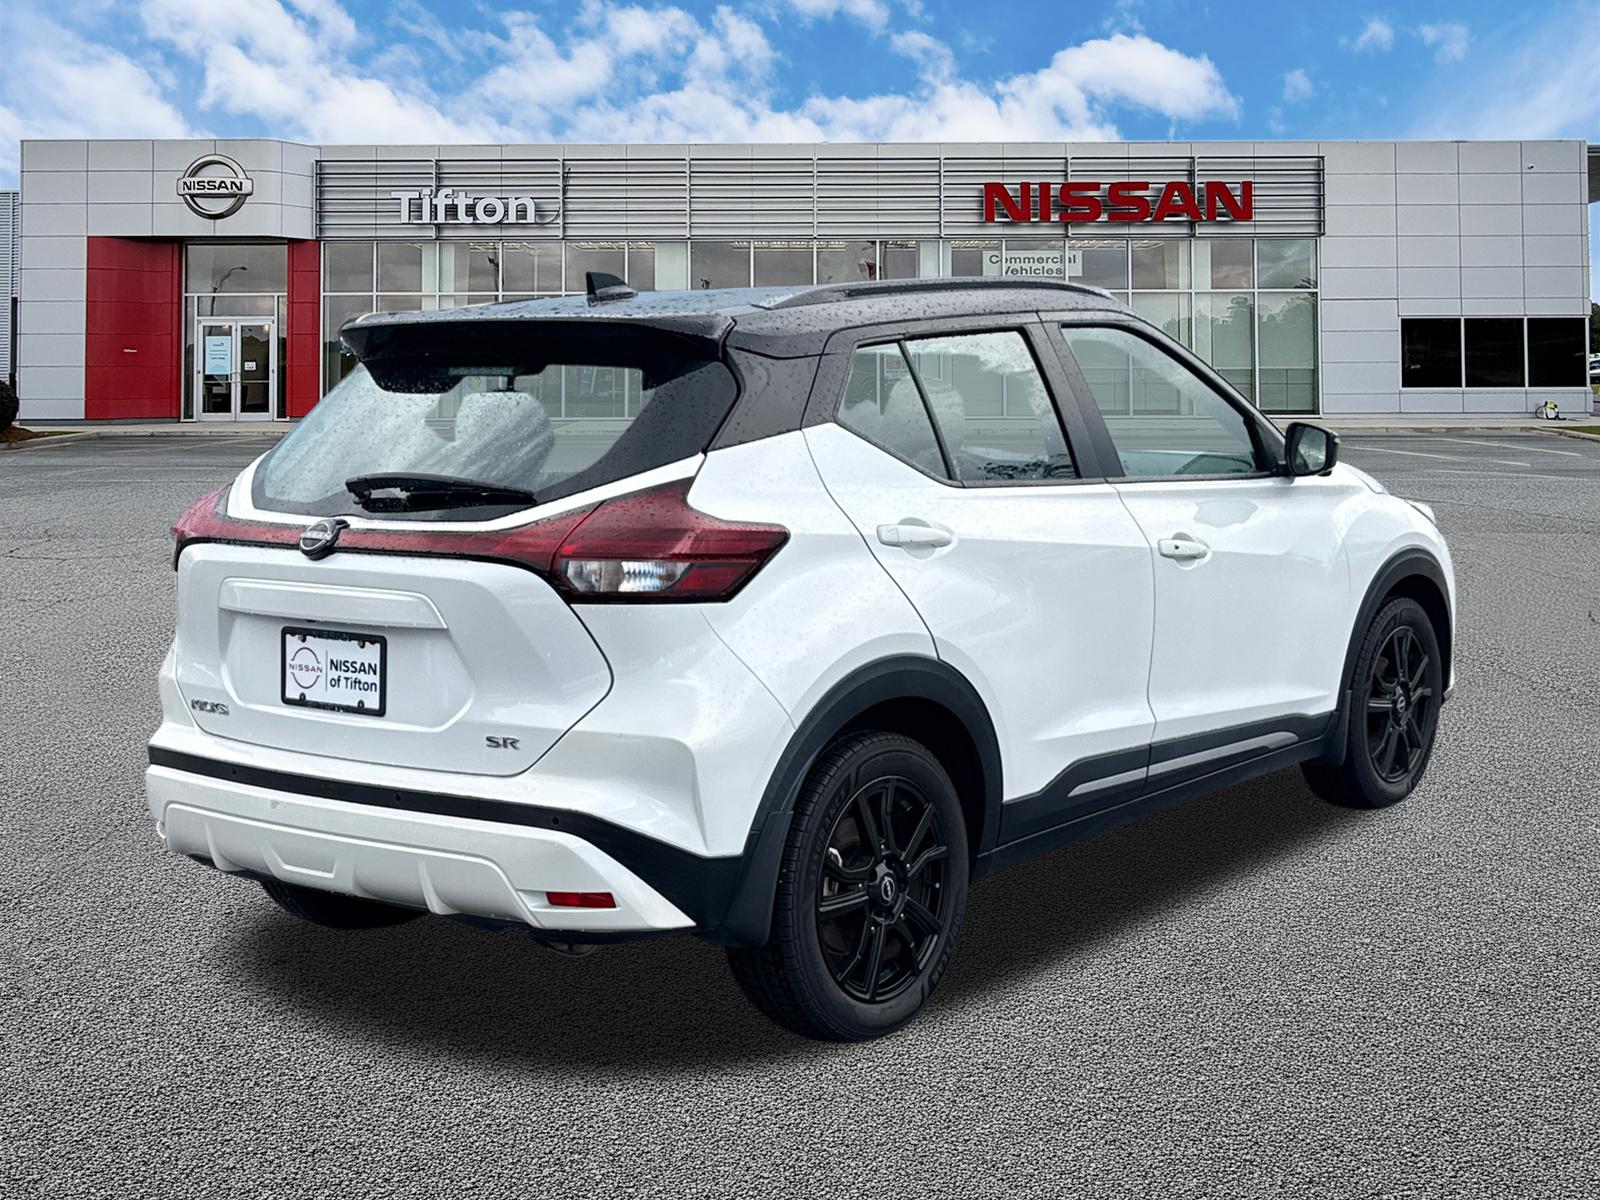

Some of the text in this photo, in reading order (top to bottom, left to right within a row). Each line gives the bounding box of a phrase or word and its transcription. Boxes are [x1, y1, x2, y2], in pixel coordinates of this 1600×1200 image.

[182, 180, 243, 192] NISSAN
[391, 188, 536, 224] Tifton
[984, 181, 1253, 222] NISSAN
[289, 663, 323, 673] NISSAN
[329, 658, 378, 676] NISSAN
[329, 675, 378, 693] of Tifton
[485, 736, 520, 750] SR
